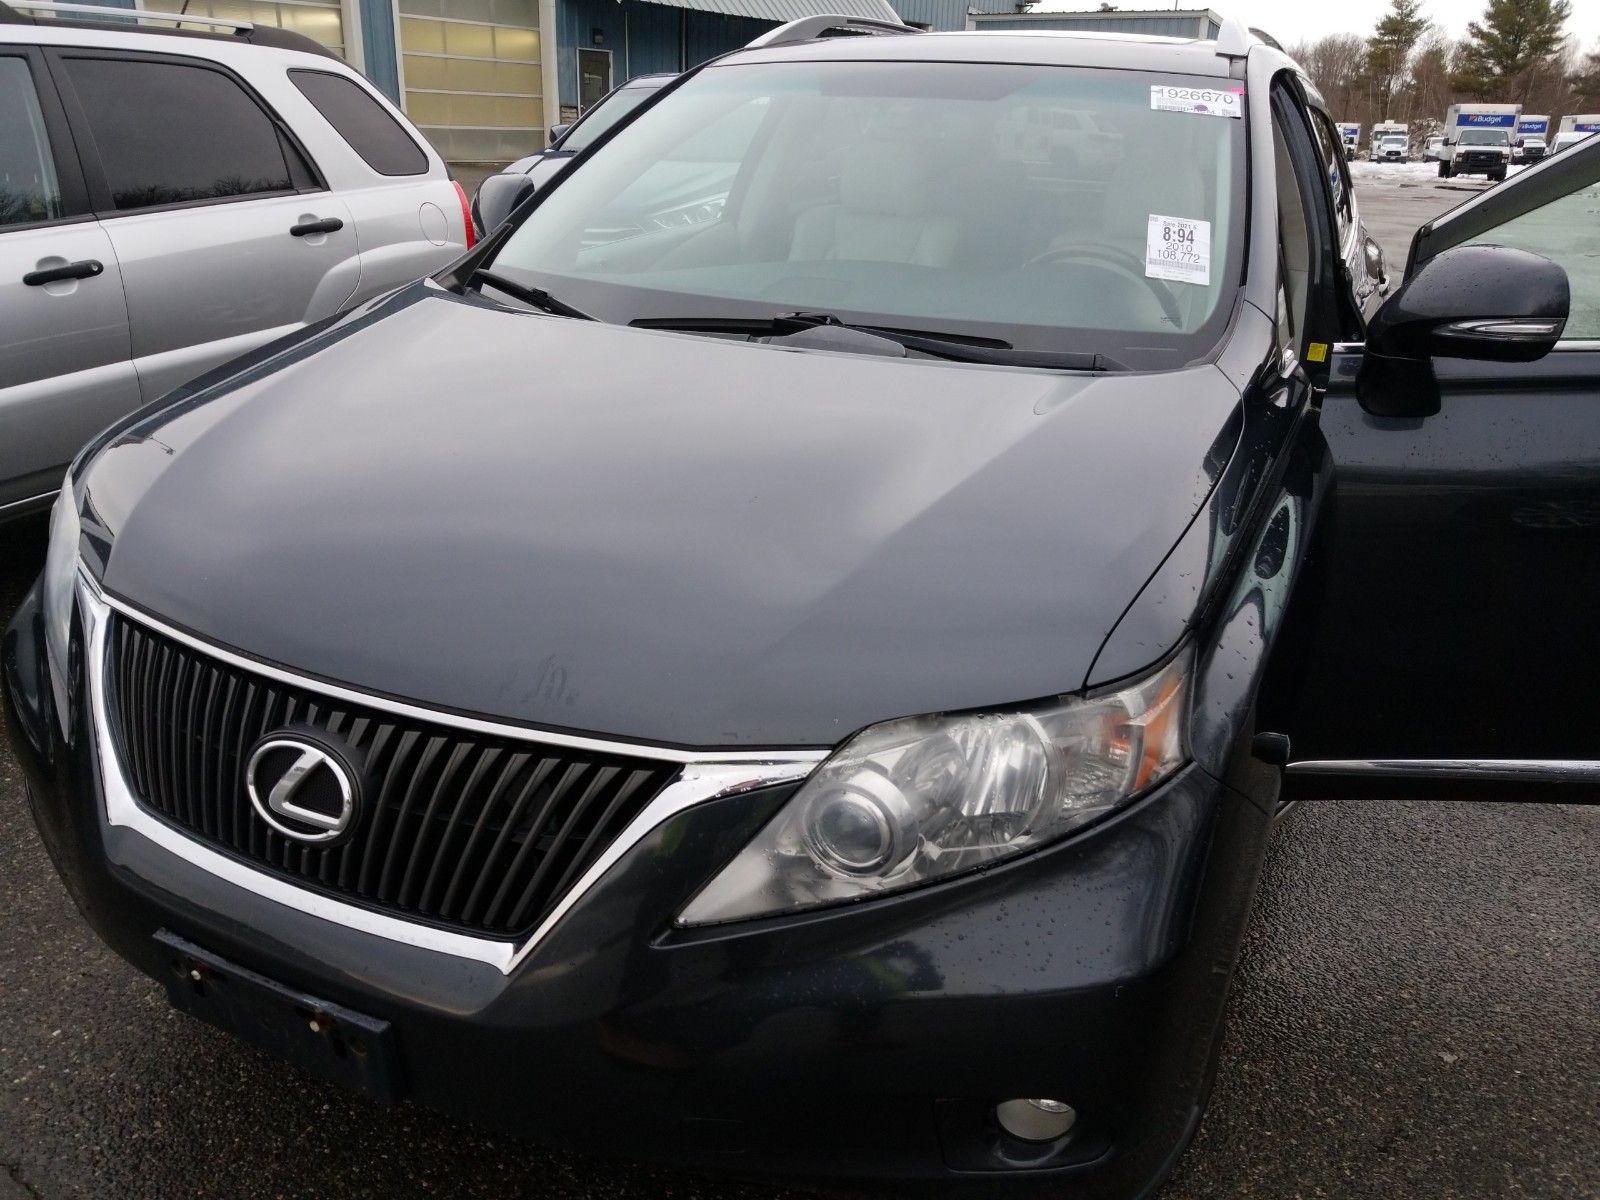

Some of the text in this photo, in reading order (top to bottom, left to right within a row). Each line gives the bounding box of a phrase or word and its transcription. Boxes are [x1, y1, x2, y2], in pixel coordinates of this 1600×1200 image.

[1159, 88, 1234, 104] 1926670
[1477, 115, 1503, 124] Budget
[1163, 226, 1194, 244] 8:94
[1165, 241, 1193, 253] 2010
